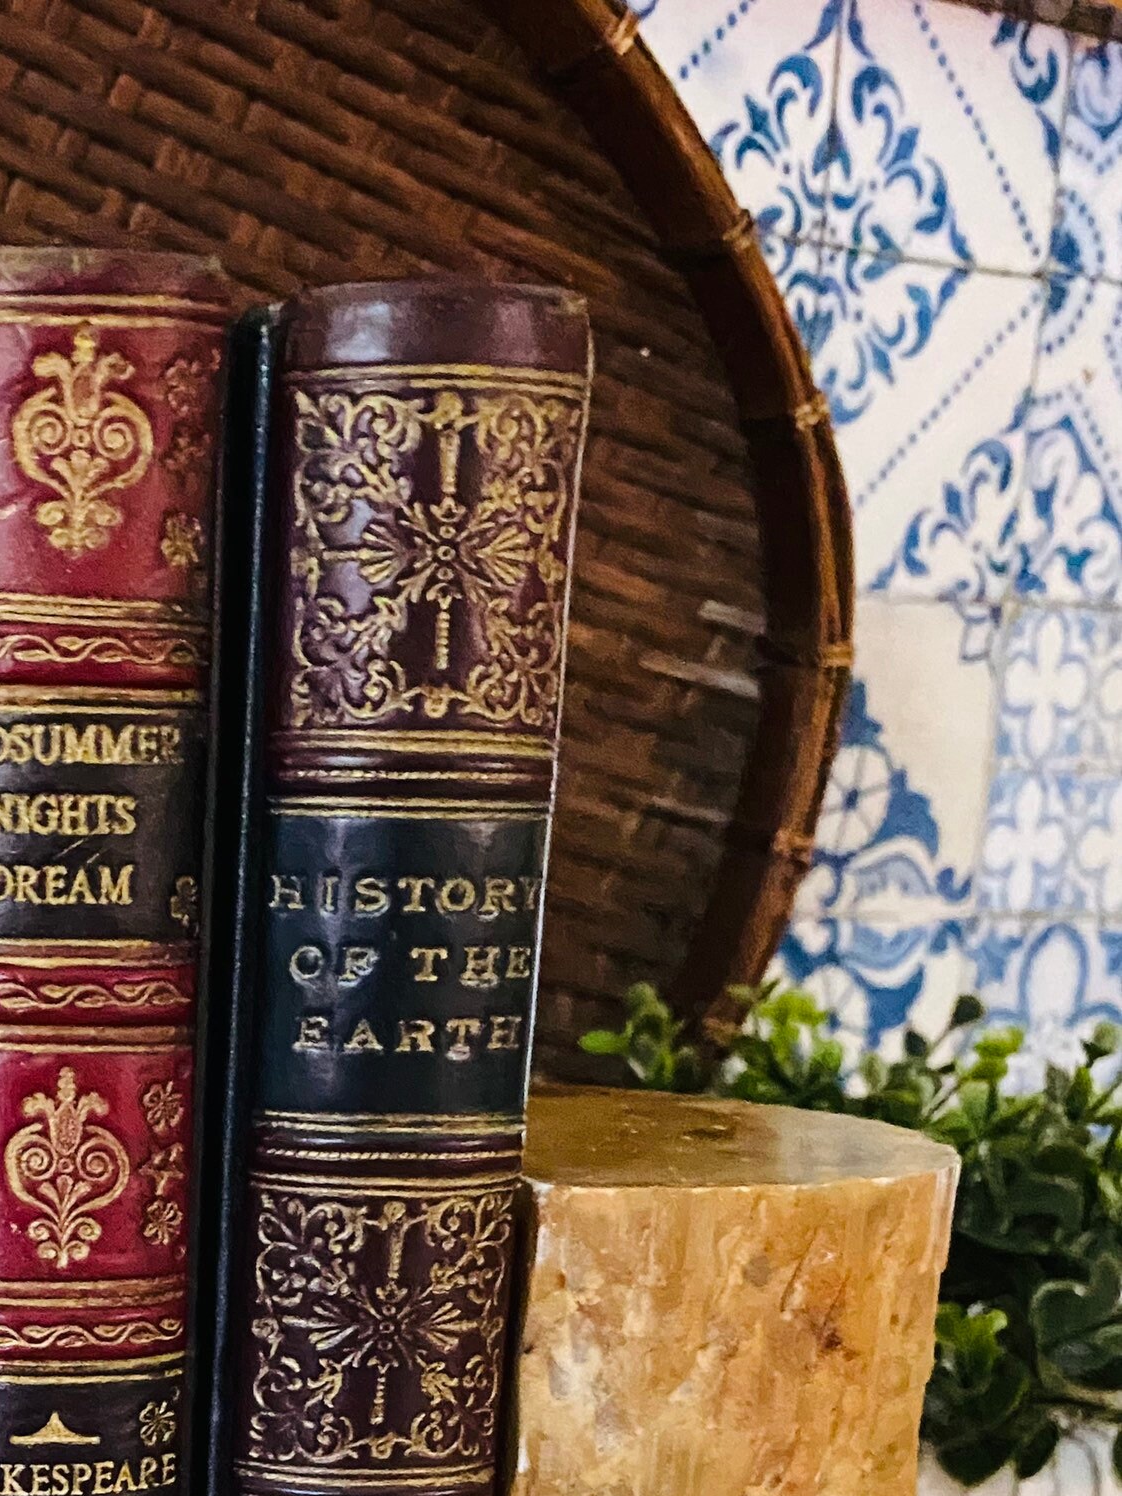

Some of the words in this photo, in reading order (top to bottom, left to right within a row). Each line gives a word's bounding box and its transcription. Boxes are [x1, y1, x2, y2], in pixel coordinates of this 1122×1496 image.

[268, 873, 542, 916] HISTORY
[288, 945, 380, 985] OF
[410, 945, 531, 985] THE
[291, 1014, 523, 1056] EARTH
